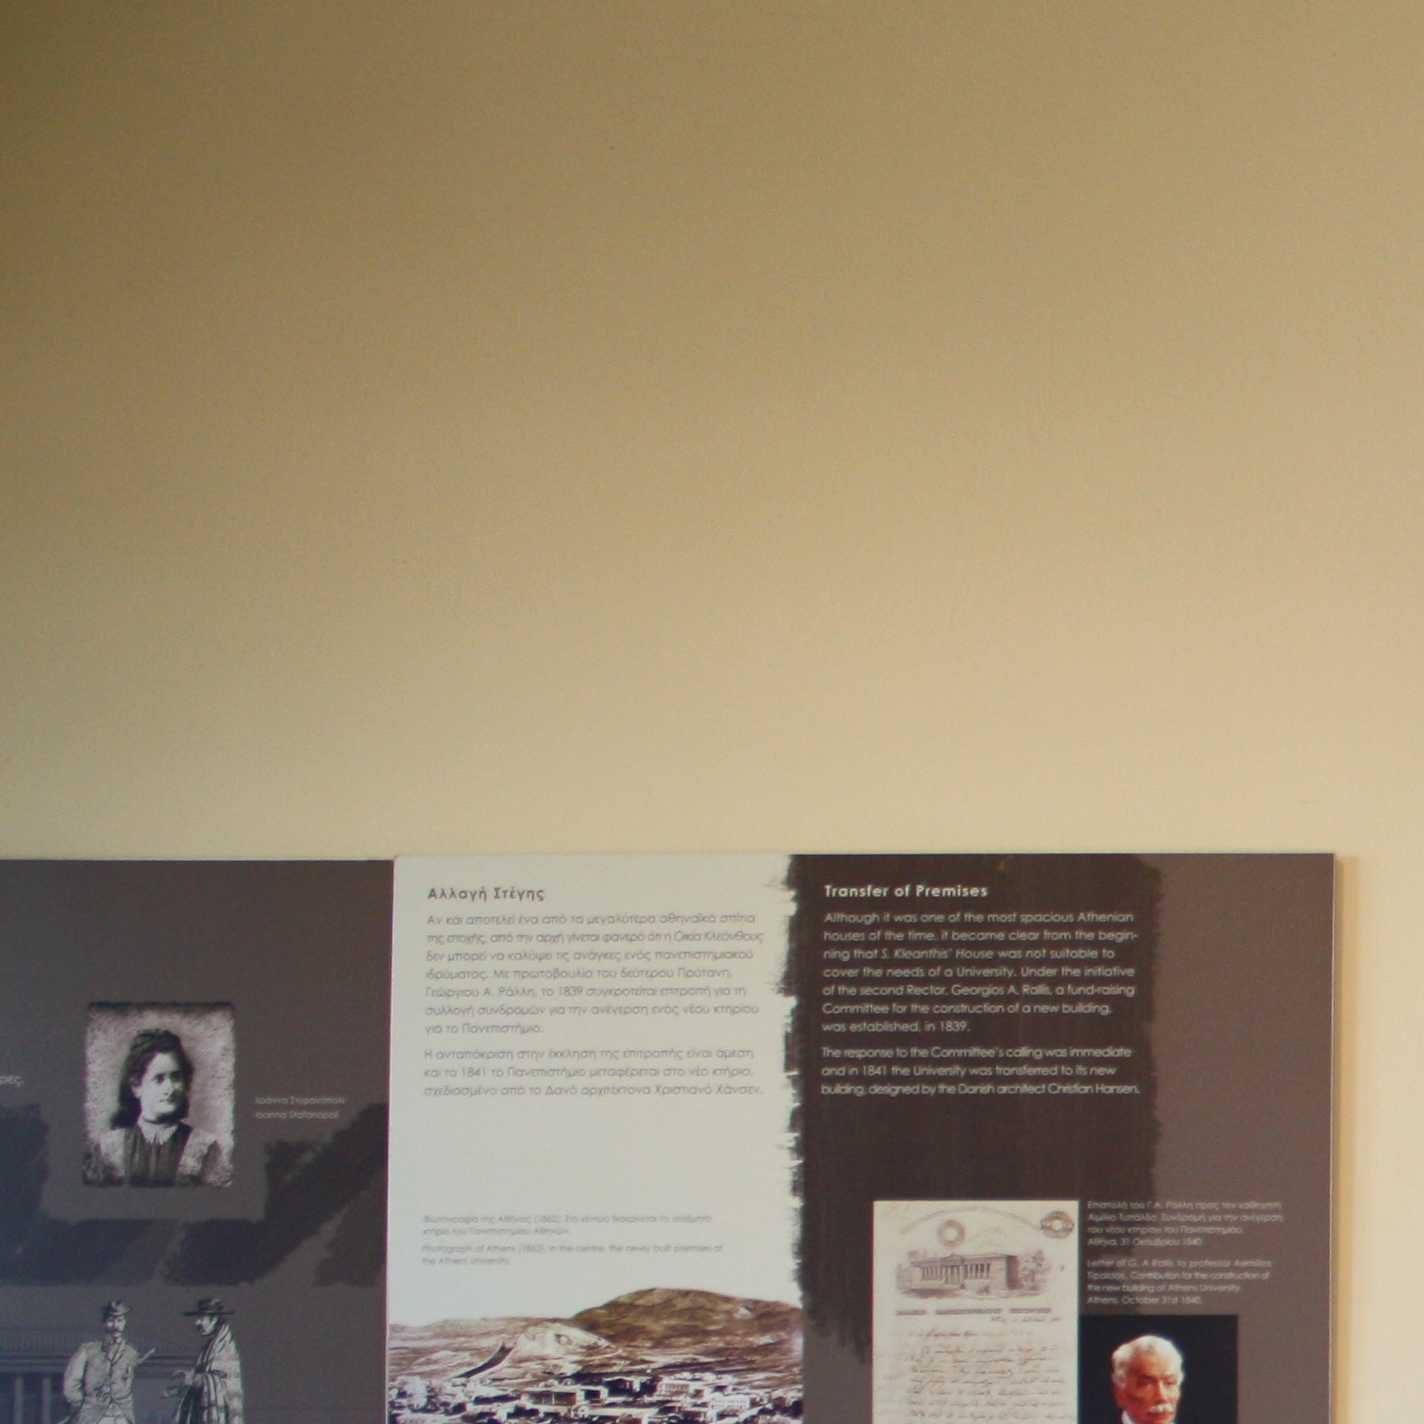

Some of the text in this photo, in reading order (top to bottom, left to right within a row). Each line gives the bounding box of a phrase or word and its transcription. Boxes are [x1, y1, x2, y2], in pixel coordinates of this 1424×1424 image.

[428, 887, 544, 903] Αλλαγή Στέγης
[825, 885, 988, 898] Transfer of Premises
[824, 912, 1134, 925] Although it was one of the most spacious Athenian
[824, 930, 865, 941] houses
[869, 930, 881, 941] of
[884, 930, 904, 941] the
[941, 930, 948, 941] it
[951, 930, 1005, 941] became
[1008, 930, 1040, 941] clear
[1044, 930, 1071, 941] from
[1075, 930, 1095, 941] the
[1098, 930, 1138, 943] begin-
[823, 948, 1115, 962] ning that S. Kleanthis' House was not suitable to
[823, 966, 1135, 980] cover the needs of a University. Under the initiative
[822, 984, 835, 996] of
[838, 984, 857, 996] the
[860, 984, 904, 996] second
[951, 984, 1004, 998] Georgios
[1008, 984, 1018, 996] A.
[1056, 987, 1064, 996] a
[1067, 984, 1136, 998] fund-raising
[822, 1003, 889, 1014] Committee
[892, 1003, 907, 1014] for
[911, 1003, 930, 1014] the
[933, 1003, 1005, 1014] construction
[1007, 1003, 1020, 1014] of
[1022, 1006, 1032, 1014] a
[1033, 1006, 1060, 1014] new
[822, 1024, 846, 1032] was
[925, 1021, 936, 1032] in
[941, 1021, 970, 1032] 1839.
[822, 1047, 1132, 1061] The response to the Committee's calling was immediate
[821, 1065, 1116, 1079] and in 1841 the University was transferred to its new
[868, 1083, 920, 1097] designed
[921, 1083, 936, 1097] by
[938, 1083, 956, 1094] the
[958, 1083, 995, 1094] Danish
[997, 1083, 1046, 1094] architect
[1048, 1083, 1094, 1094] Christian
[1096, 1083, 1140, 1094] Hansen.
